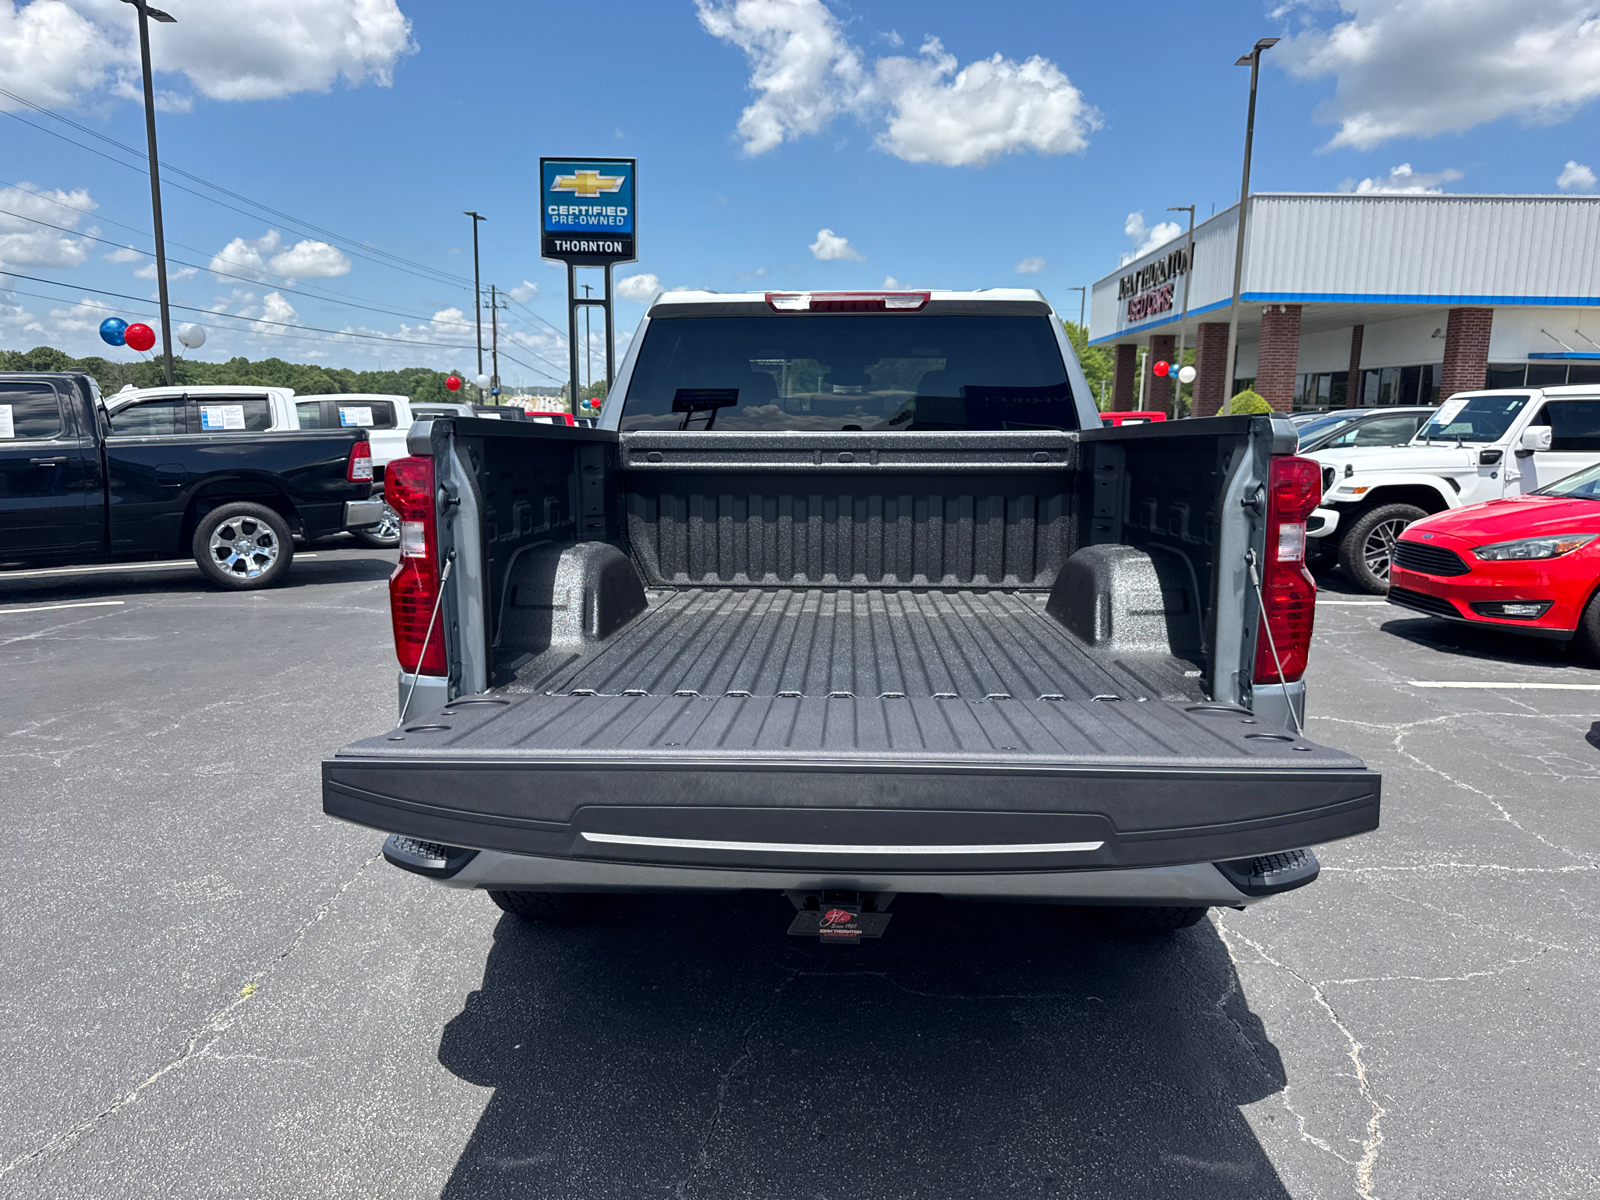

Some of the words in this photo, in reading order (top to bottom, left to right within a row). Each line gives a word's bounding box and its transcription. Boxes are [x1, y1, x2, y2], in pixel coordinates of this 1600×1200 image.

[548, 205, 628, 216] CERTIFIED
[552, 215, 624, 225] PRE-OWNED
[555, 240, 622, 252] THORNTON
[1127, 294, 1148, 322] USED
[1147, 284, 1174, 315] CARS
